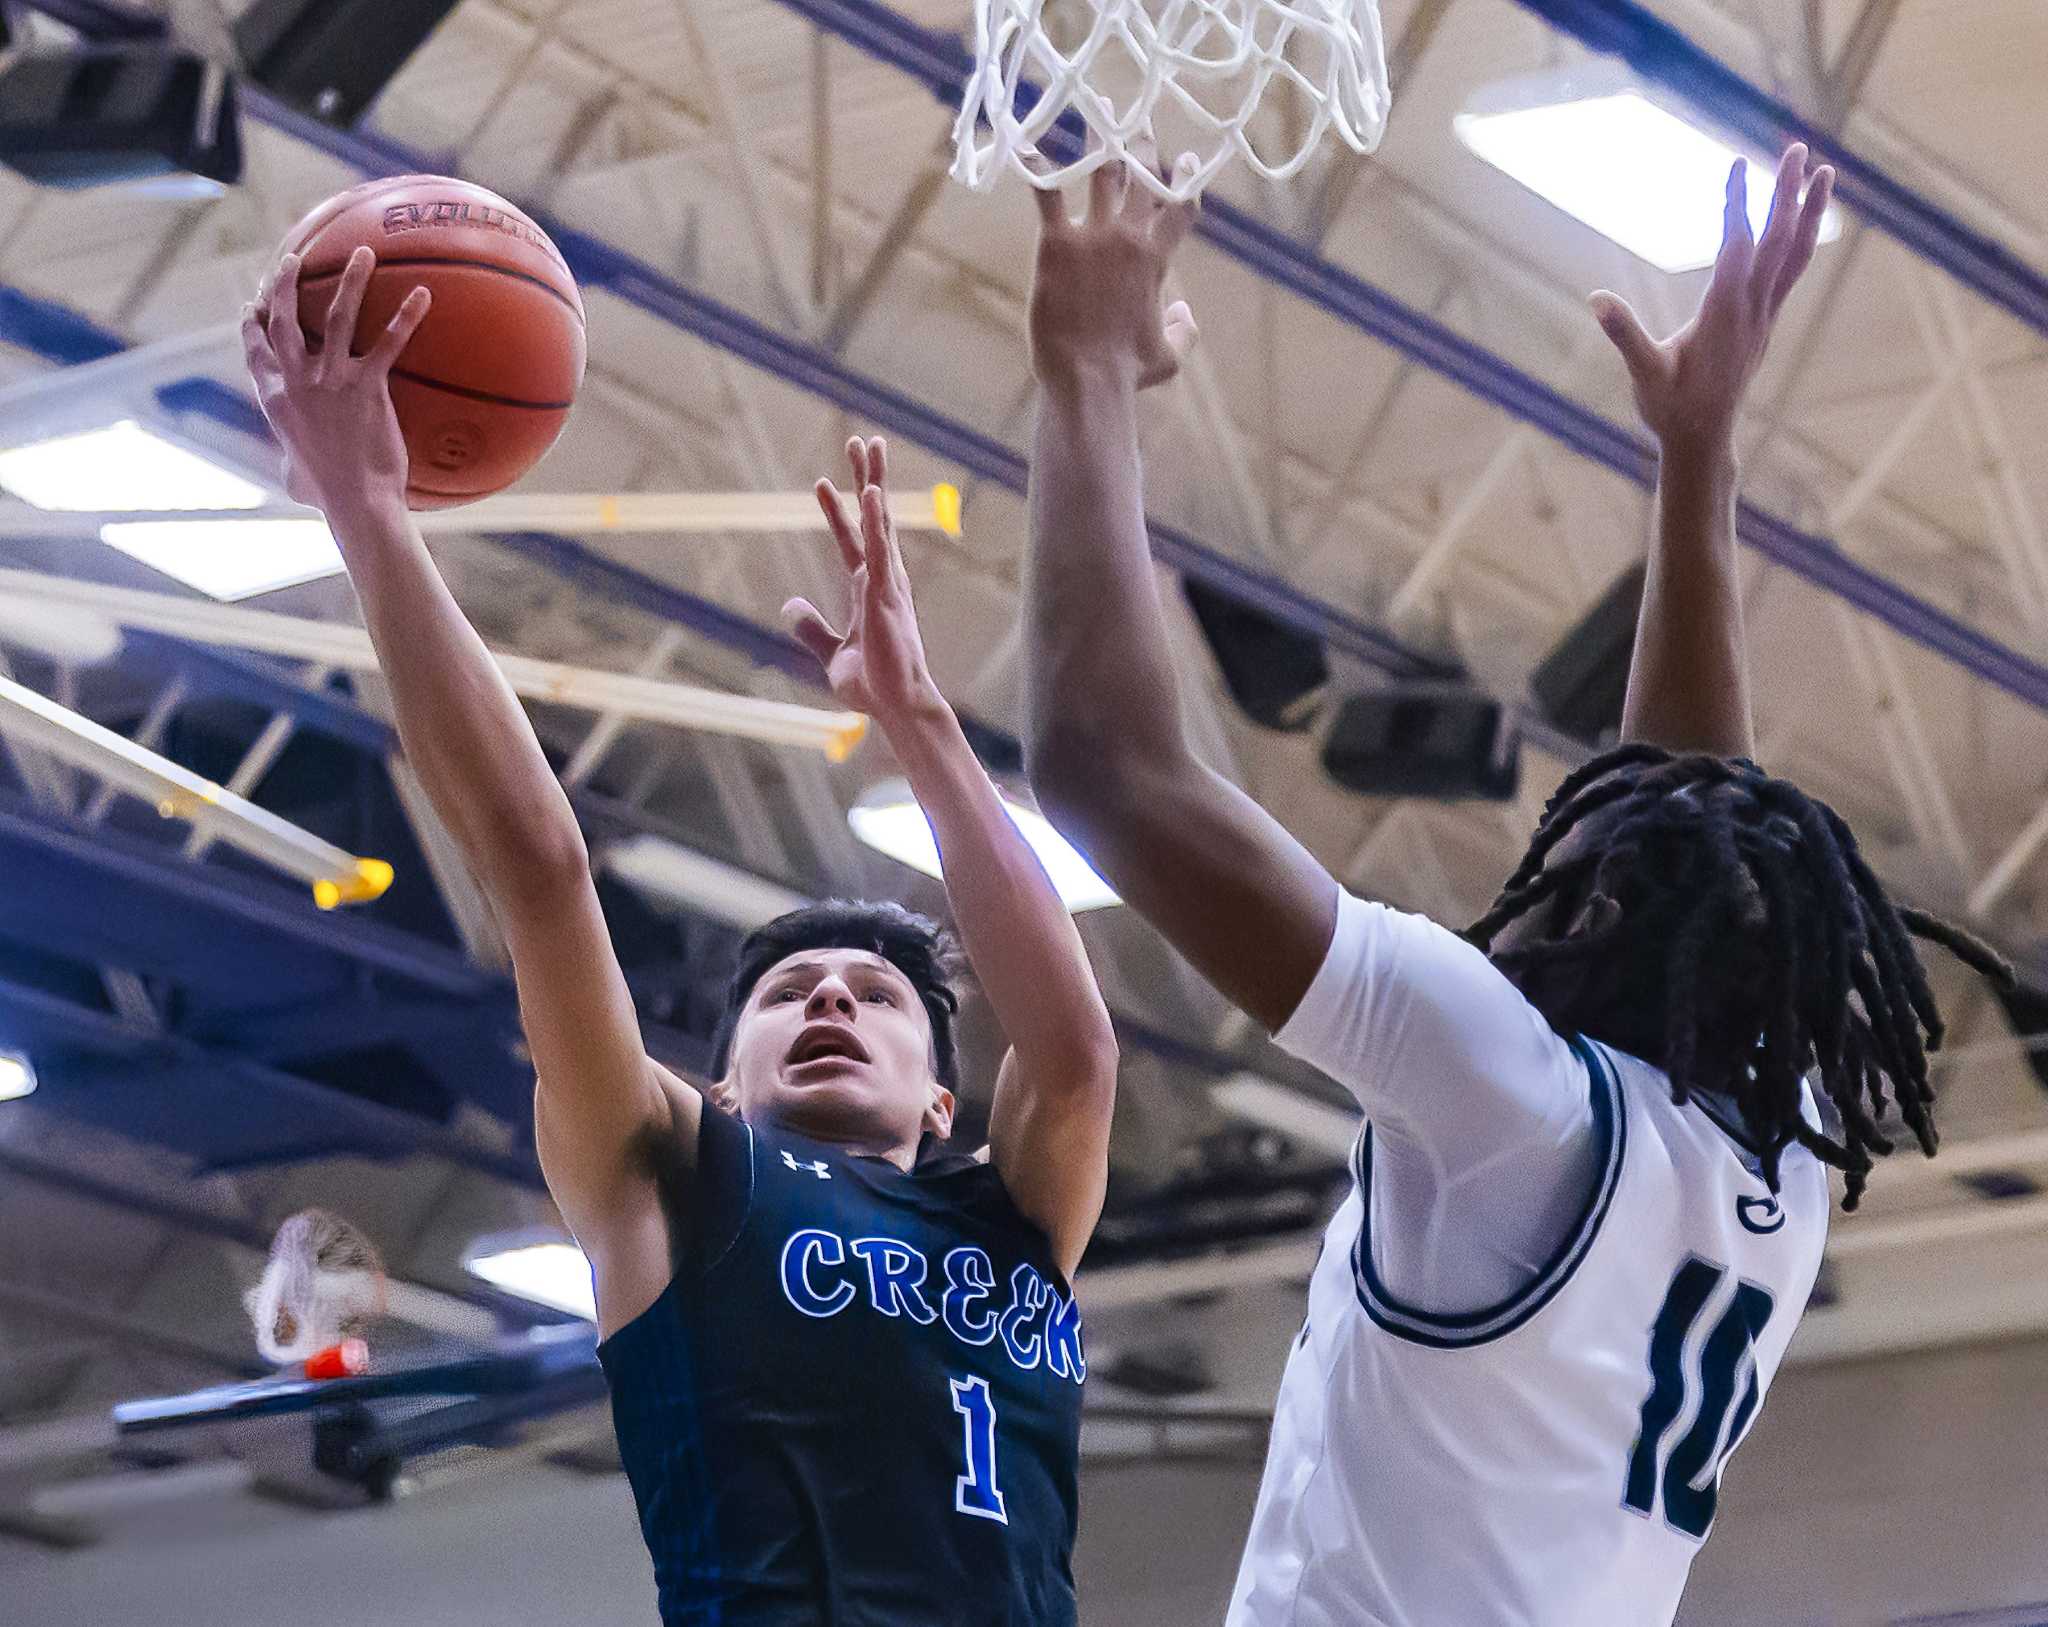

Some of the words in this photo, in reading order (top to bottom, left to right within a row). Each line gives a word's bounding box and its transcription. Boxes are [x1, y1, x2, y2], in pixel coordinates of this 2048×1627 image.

[780, 1228, 1088, 1385] CREEK
[949, 1373, 1009, 1526] 1
[1619, 1251, 1776, 1544] 10
